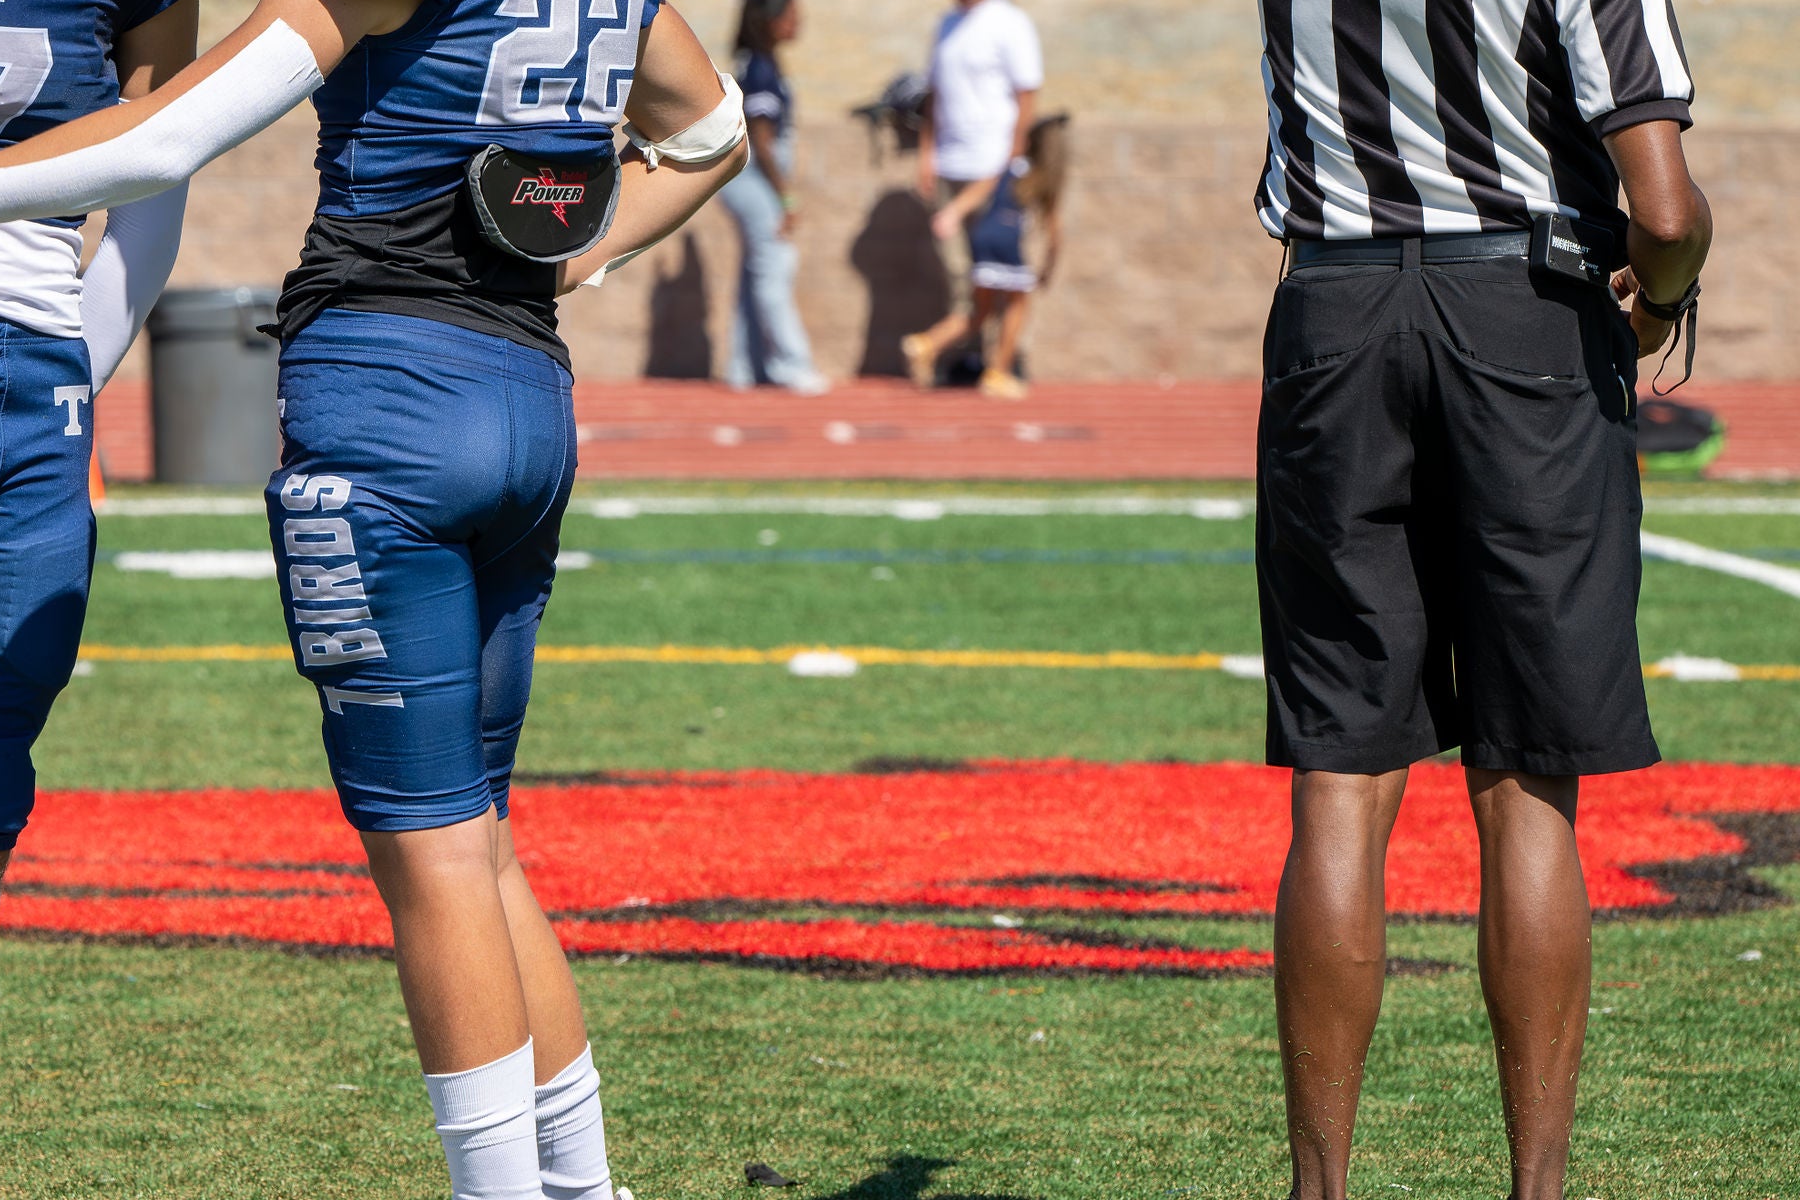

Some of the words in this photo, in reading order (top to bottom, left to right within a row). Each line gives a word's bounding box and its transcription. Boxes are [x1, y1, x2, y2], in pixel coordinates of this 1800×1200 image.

[54, 386, 91, 436] T
[281, 473, 387, 666] BIRDS
[322, 684, 405, 716] T
